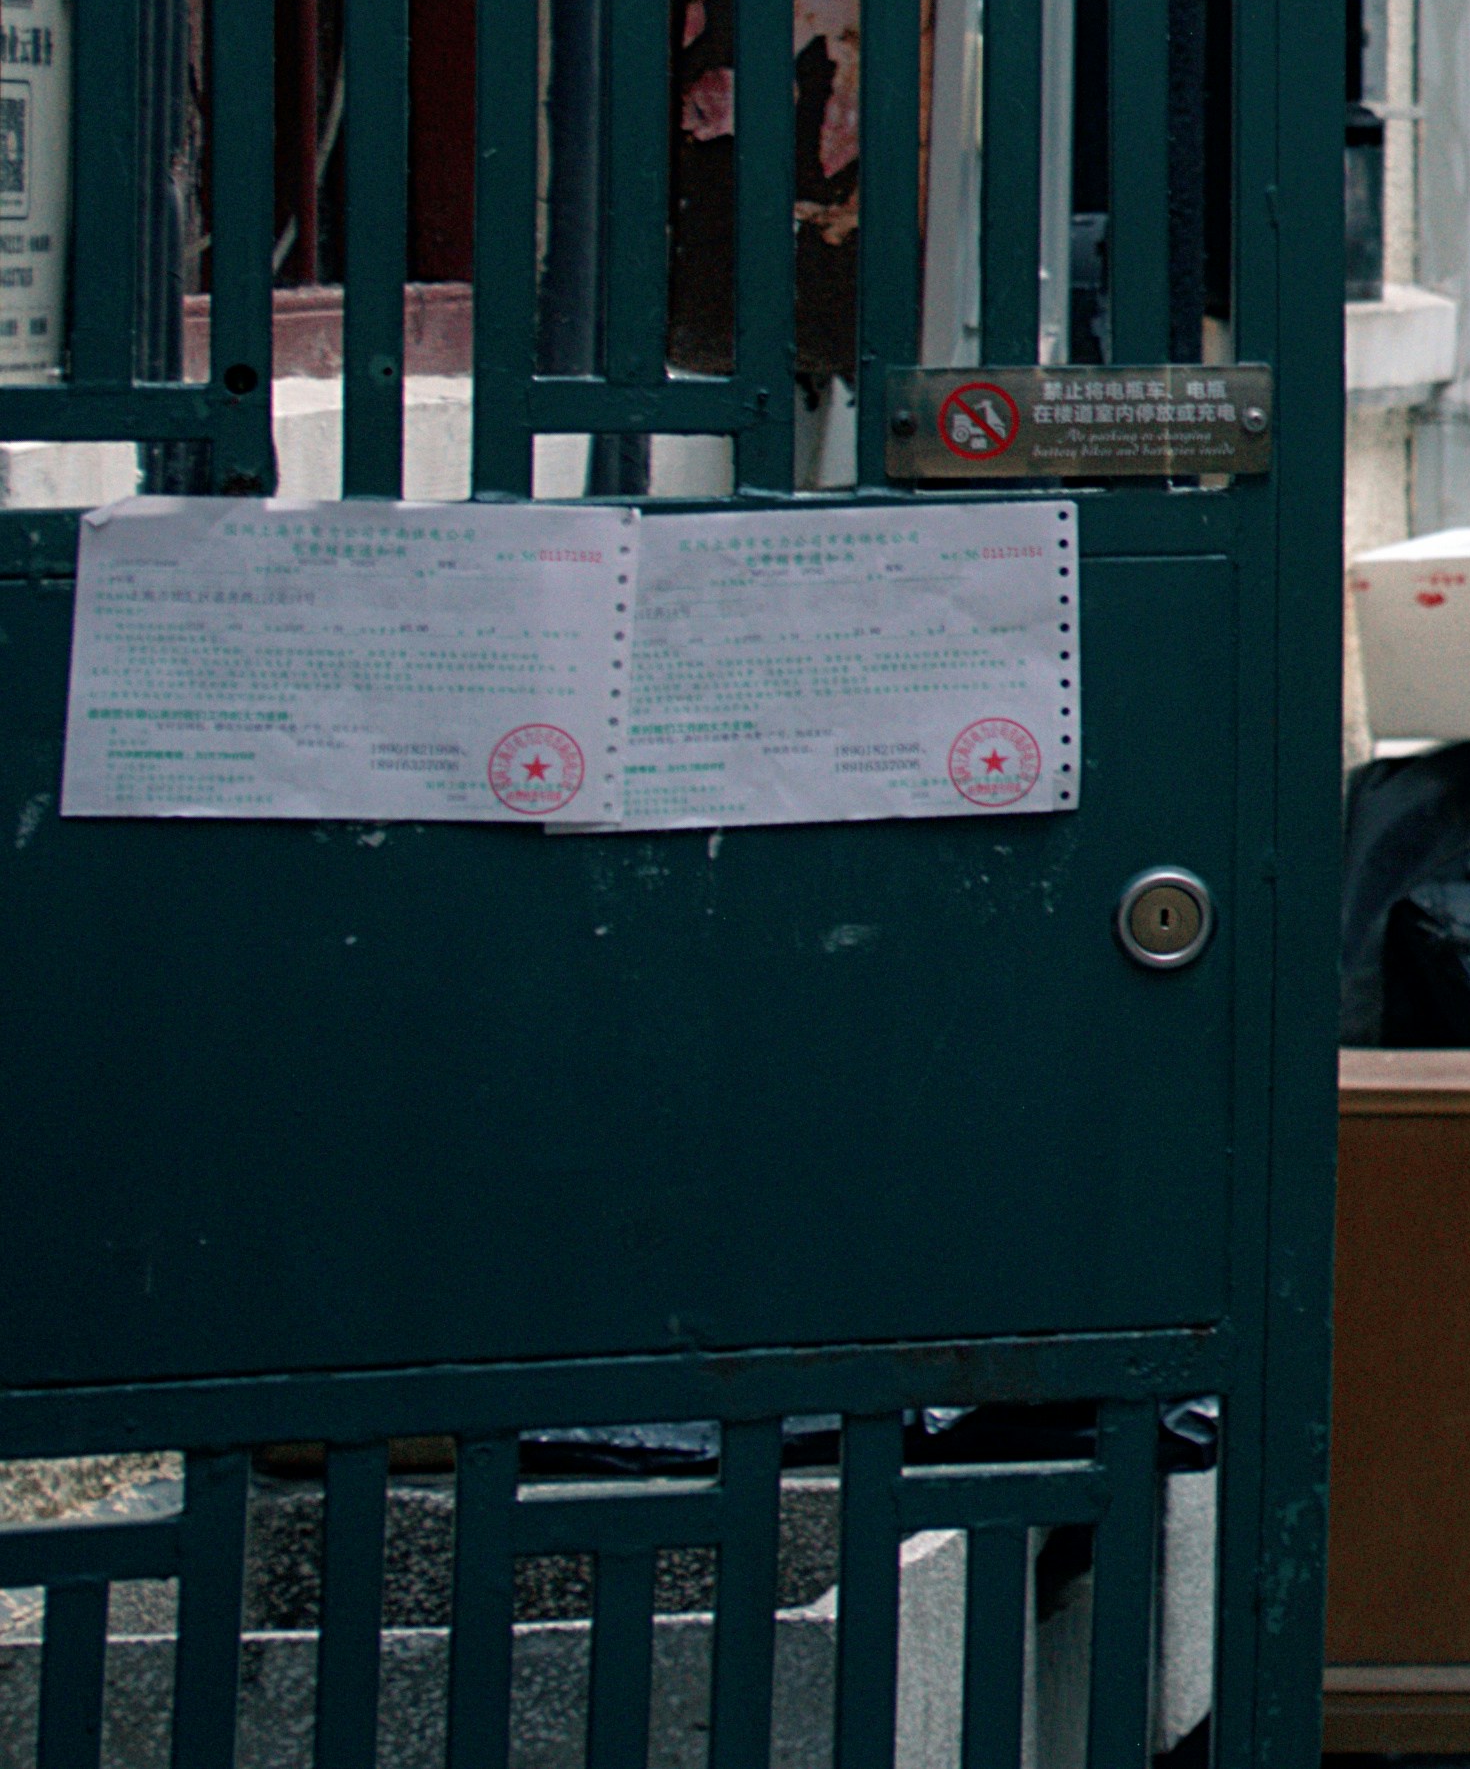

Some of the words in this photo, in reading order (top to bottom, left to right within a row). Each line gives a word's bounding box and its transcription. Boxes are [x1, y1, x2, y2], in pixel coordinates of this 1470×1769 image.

[1033, 403, 1236, 424] 在楼道室内停放或充电
